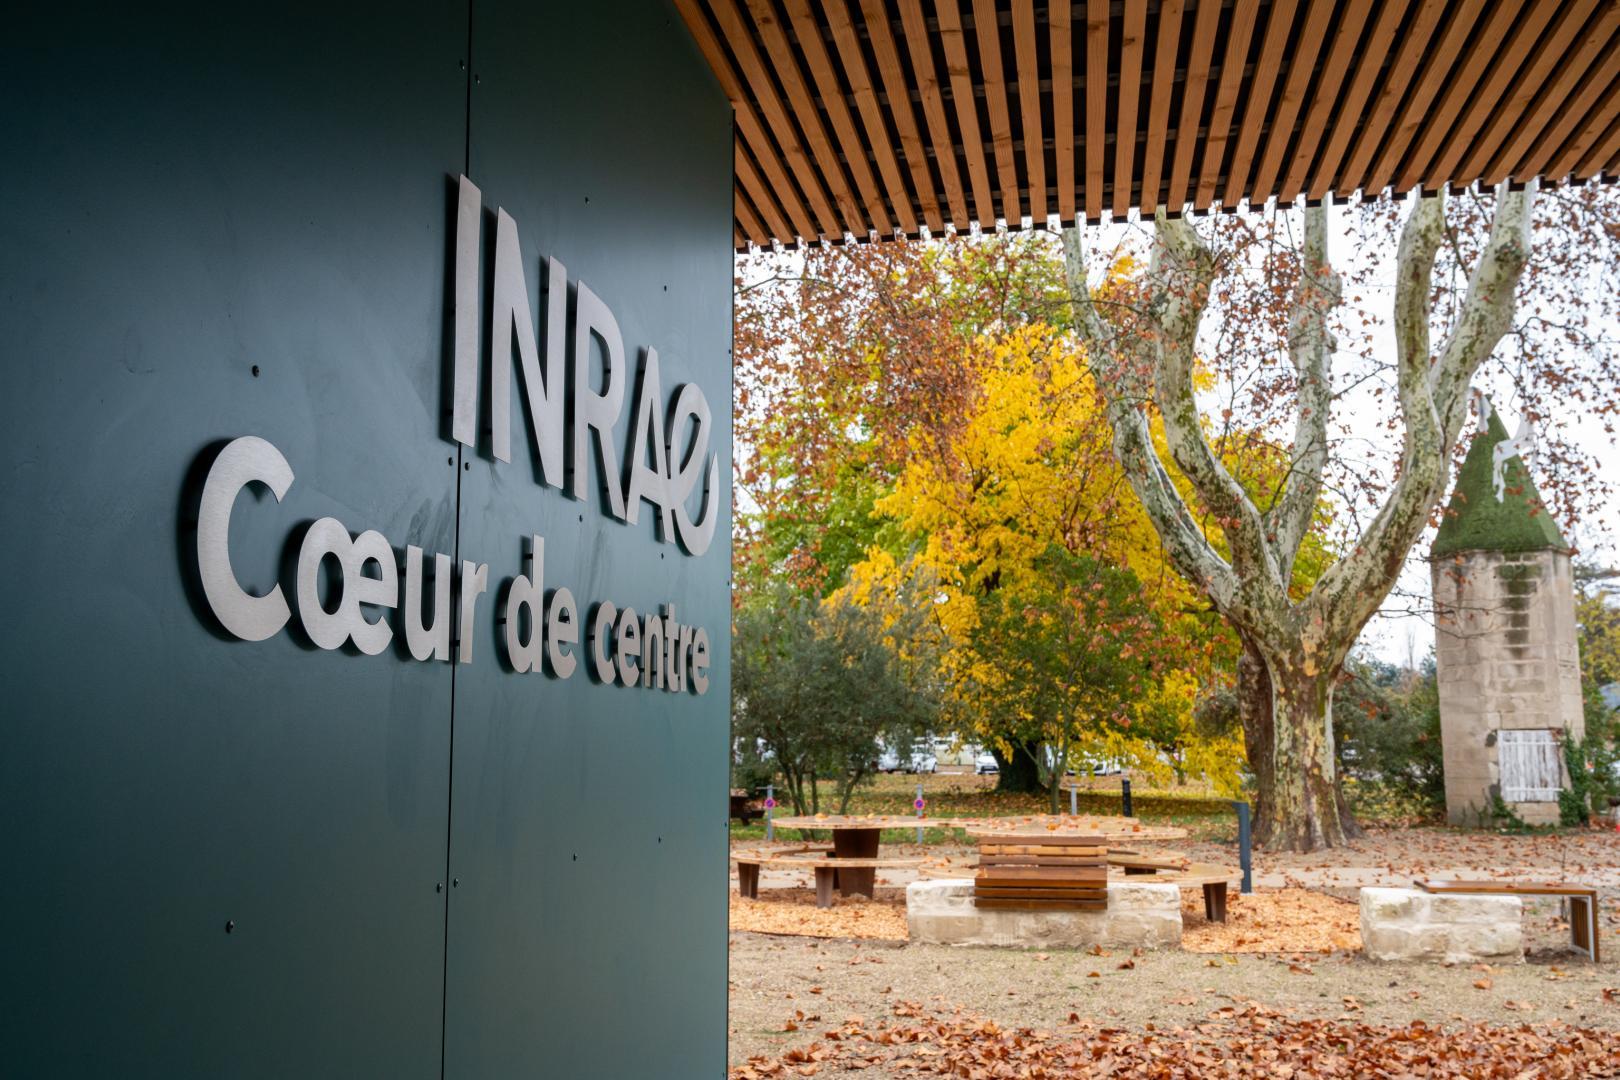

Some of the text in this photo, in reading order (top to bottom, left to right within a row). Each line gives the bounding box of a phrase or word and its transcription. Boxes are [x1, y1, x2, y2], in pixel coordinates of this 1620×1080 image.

[197, 435, 710, 695] Cœur de centre
